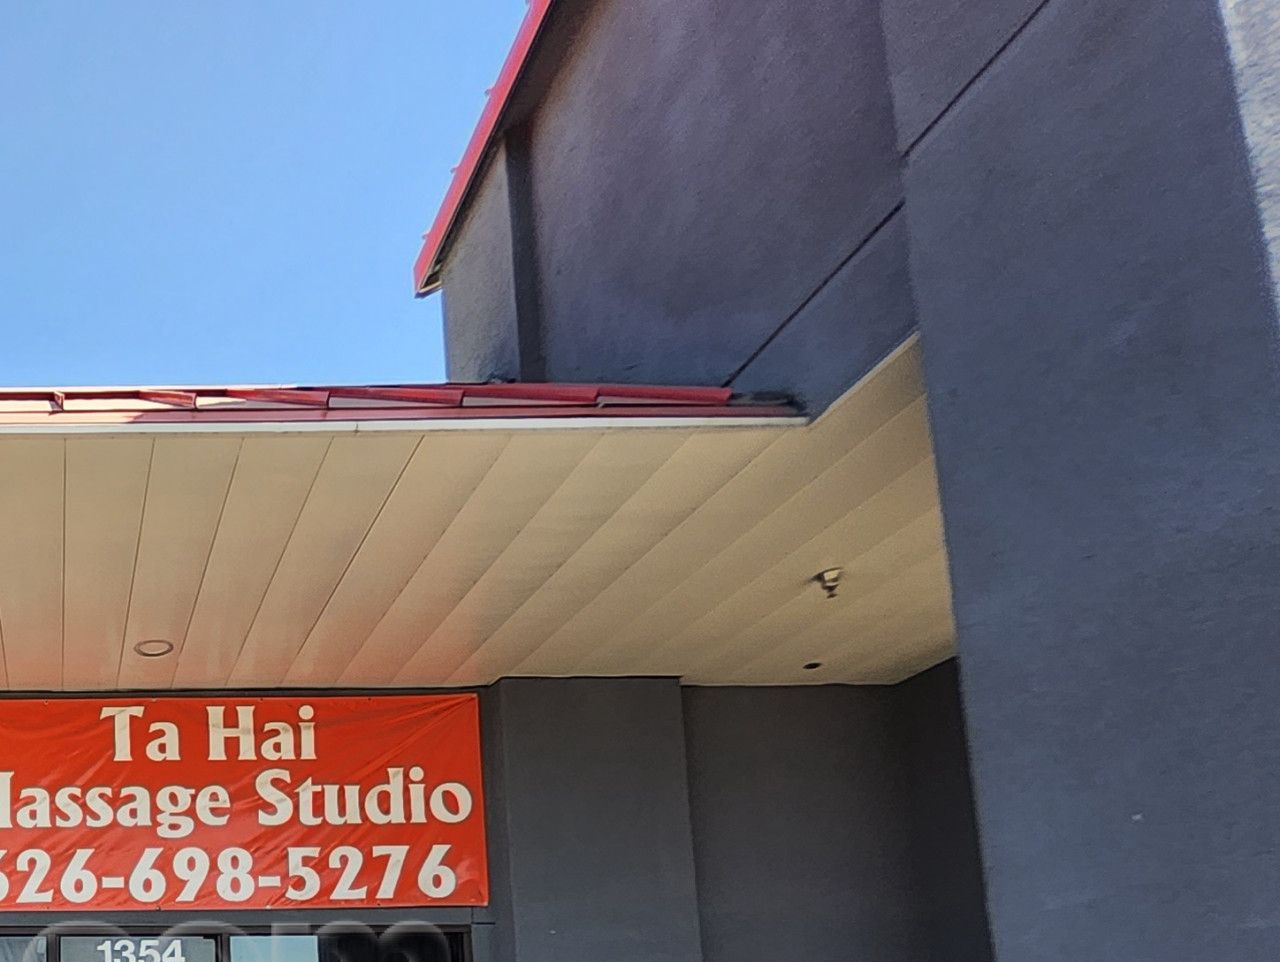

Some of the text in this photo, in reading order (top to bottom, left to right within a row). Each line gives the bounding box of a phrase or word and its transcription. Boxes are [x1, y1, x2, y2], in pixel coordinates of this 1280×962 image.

[99, 704, 318, 762] Ta Hai
[256, 766, 474, 827] Studio
